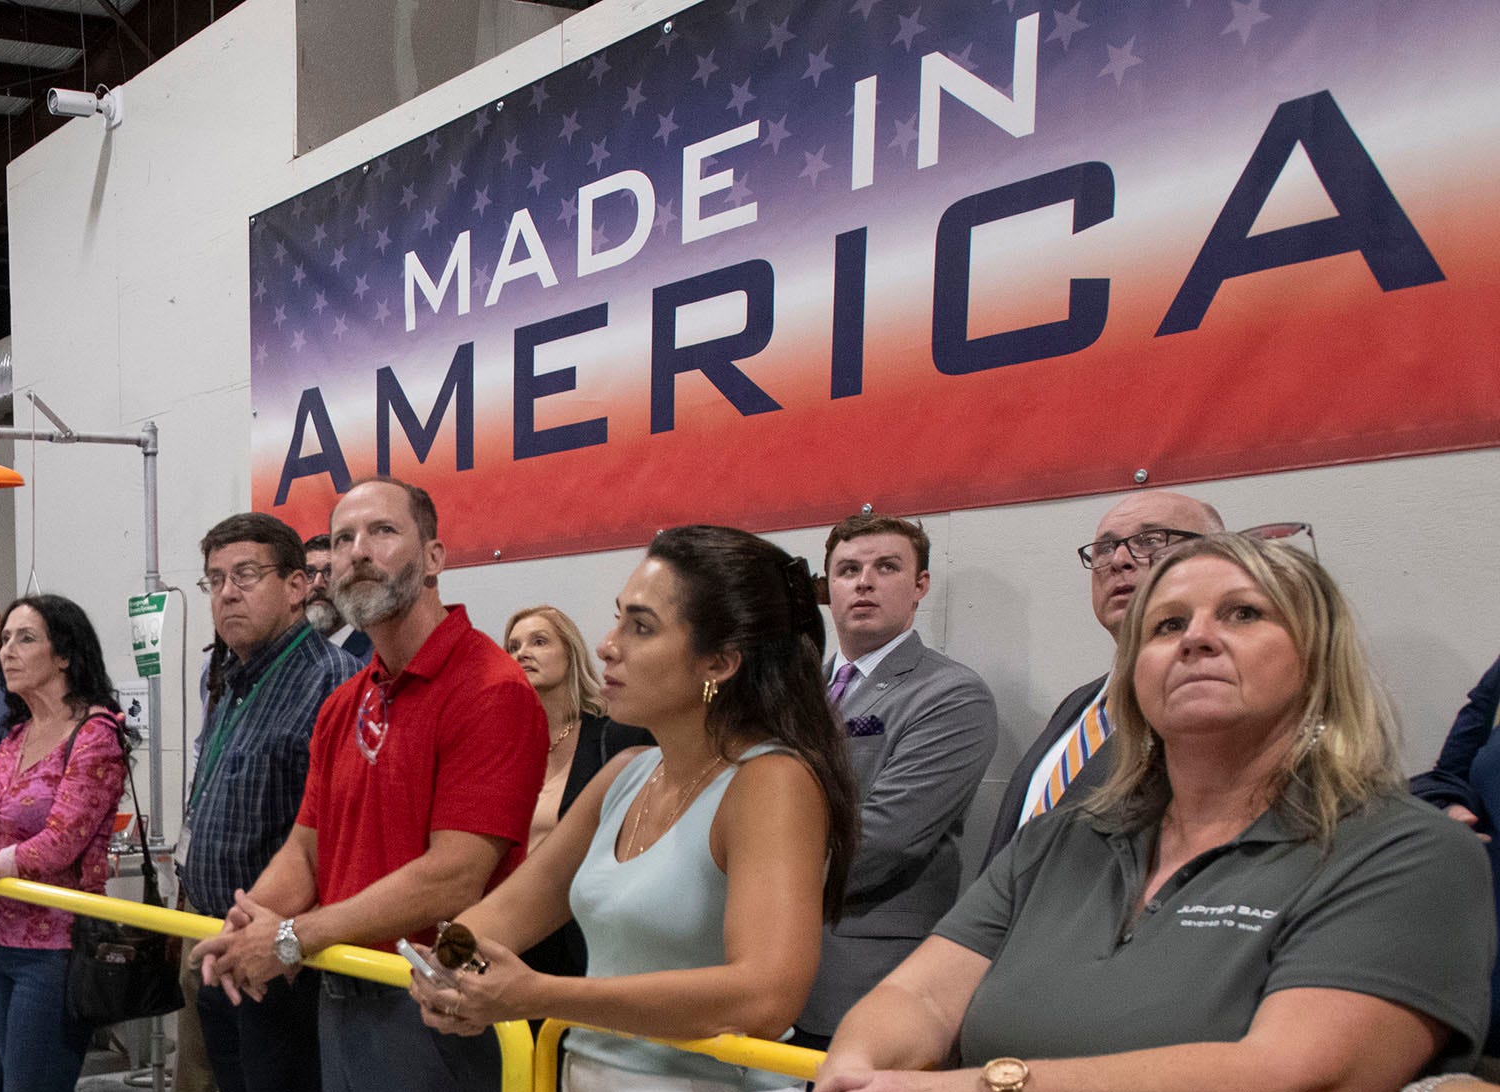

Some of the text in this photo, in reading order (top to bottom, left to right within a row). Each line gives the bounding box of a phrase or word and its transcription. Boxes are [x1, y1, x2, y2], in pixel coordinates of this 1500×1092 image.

[404, 11, 1040, 333] MADE IN
[273, 89, 1447, 508] AMERICA
[1176, 904, 1236, 915] JUPITER
[1222, 919, 1236, 927] TO
